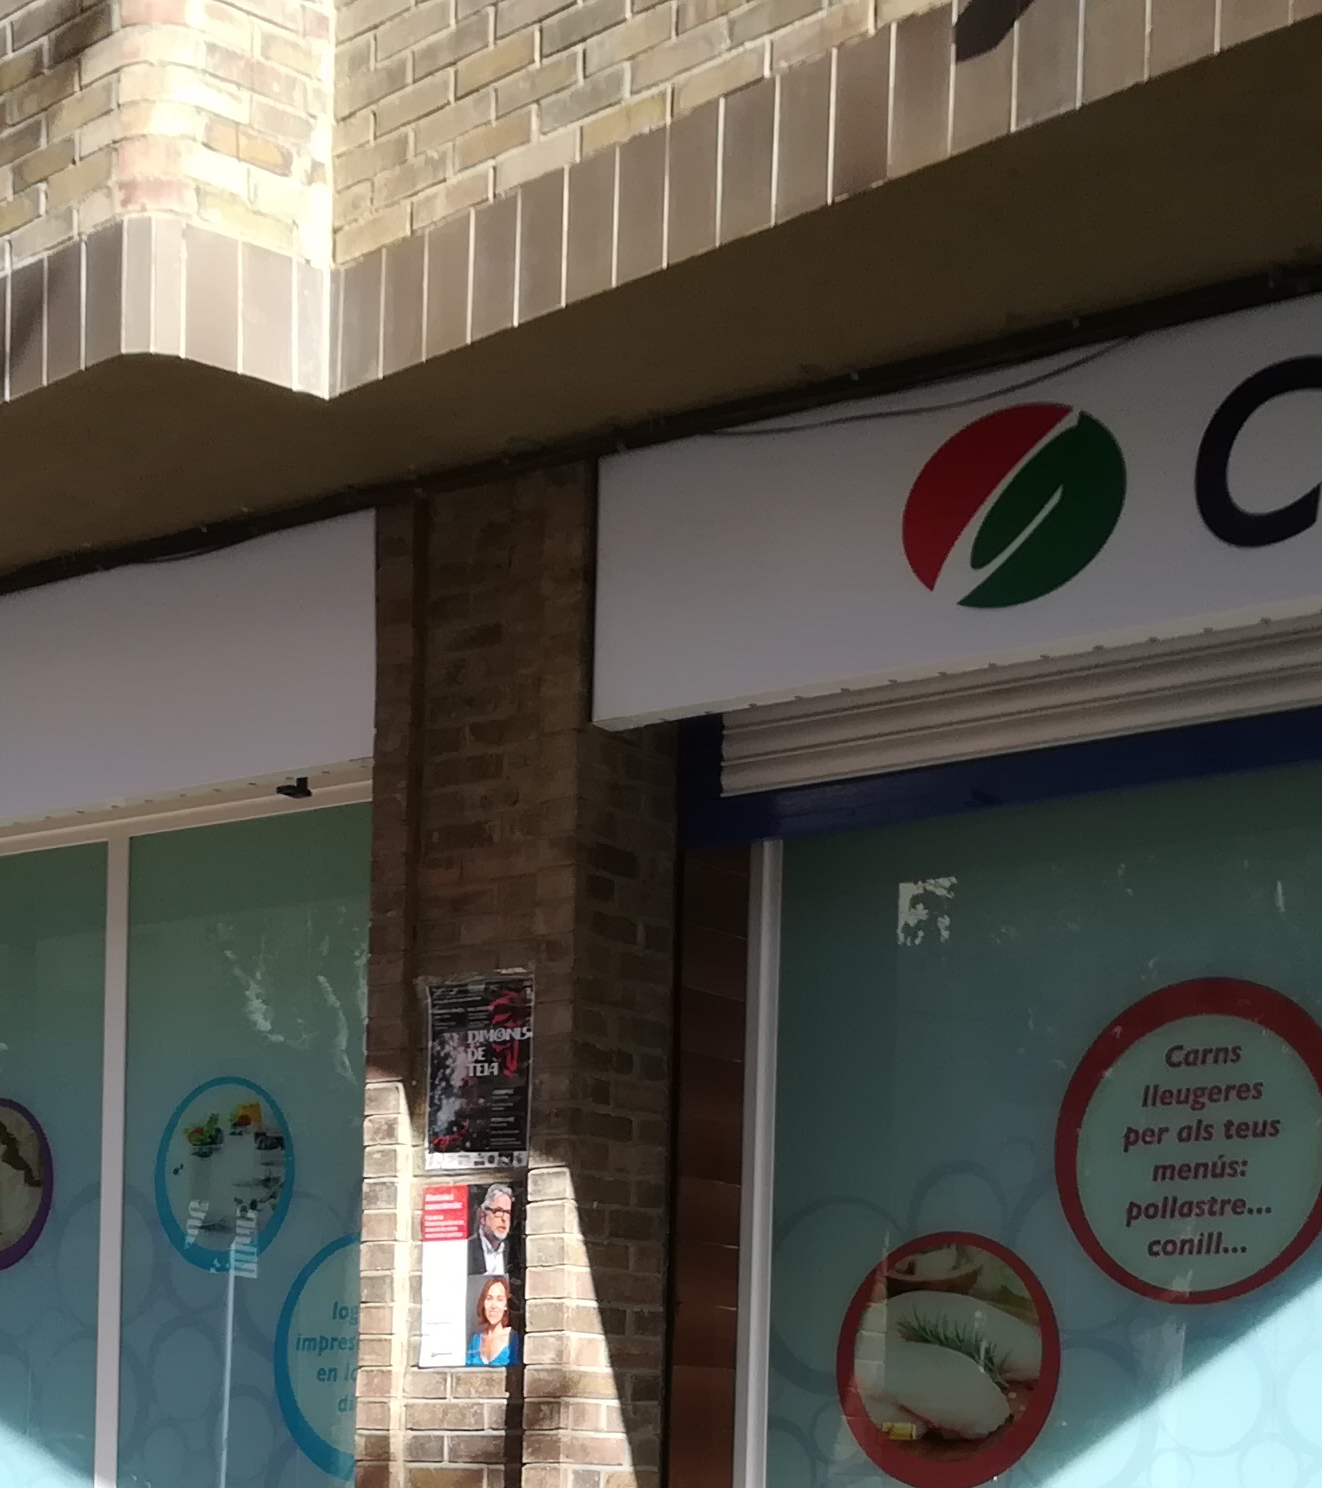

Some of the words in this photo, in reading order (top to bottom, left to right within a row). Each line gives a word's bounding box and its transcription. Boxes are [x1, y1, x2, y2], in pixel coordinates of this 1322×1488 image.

[467, 1047, 486, 1061] DE
[1165, 1045, 1243, 1068] Carns
[1141, 1081, 1264, 1111] lleugeres
[1123, 1126, 1170, 1153] per
[1177, 1119, 1214, 1143] als
[1223, 1119, 1281, 1140] teus
[1152, 1154, 1248, 1182] menús:
[1125, 1196, 1272, 1228] pollastre...
[1147, 1231, 1248, 1257] conill...
[331, 1301, 359, 1326] log
[296, 1333, 359, 1356] impres
[316, 1366, 338, 1382] en
